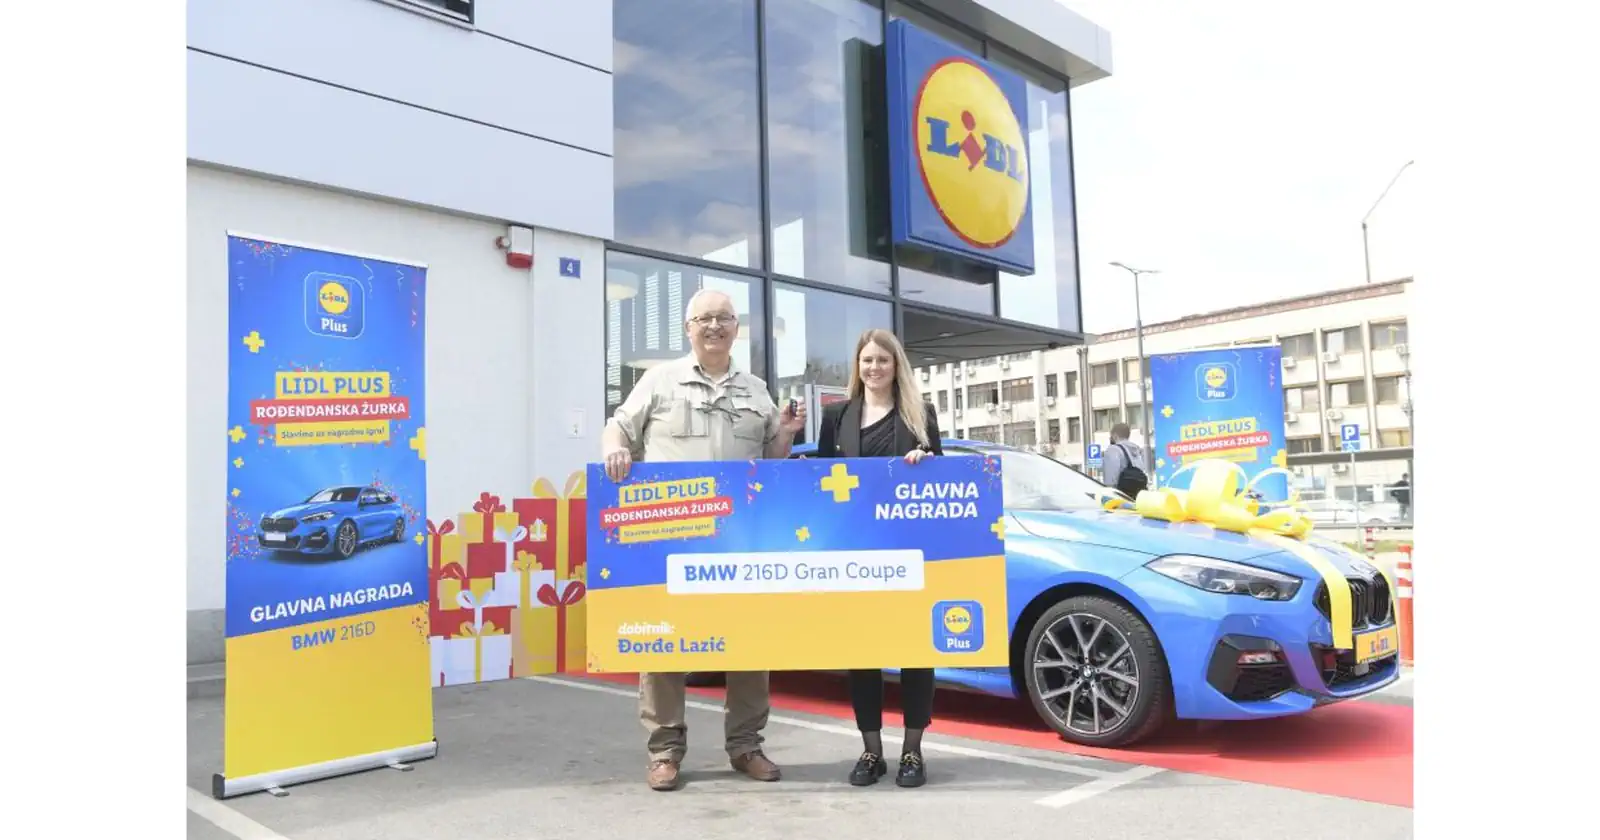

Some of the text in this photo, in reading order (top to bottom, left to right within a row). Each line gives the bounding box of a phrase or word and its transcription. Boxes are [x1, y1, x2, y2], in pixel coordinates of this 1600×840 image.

[566, 262, 574, 274] 4
[321, 317, 348, 333] Plus
[282, 377, 384, 394] LIDL PLUS
[256, 401, 406, 418] ROĐENDANSKA ŽURKA
[1184, 420, 1252, 439] LIDL PLUS
[1344, 426, 1356, 440] P
[624, 482, 709, 503] LIDL PLUS
[895, 482, 980, 500] GLAVNA
[604, 500, 729, 524] ROĐENDANSKA ŽURKA
[875, 500, 978, 520] NAGRADA
[684, 561, 907, 583] BMW 216D Gran Coupe
[250, 581, 413, 623] GLAVNA NAGRADA
[291, 621, 376, 650] BMW 216D
[946, 637, 971, 649] Plus
[617, 637, 726, 653] Đorđe Lazić
